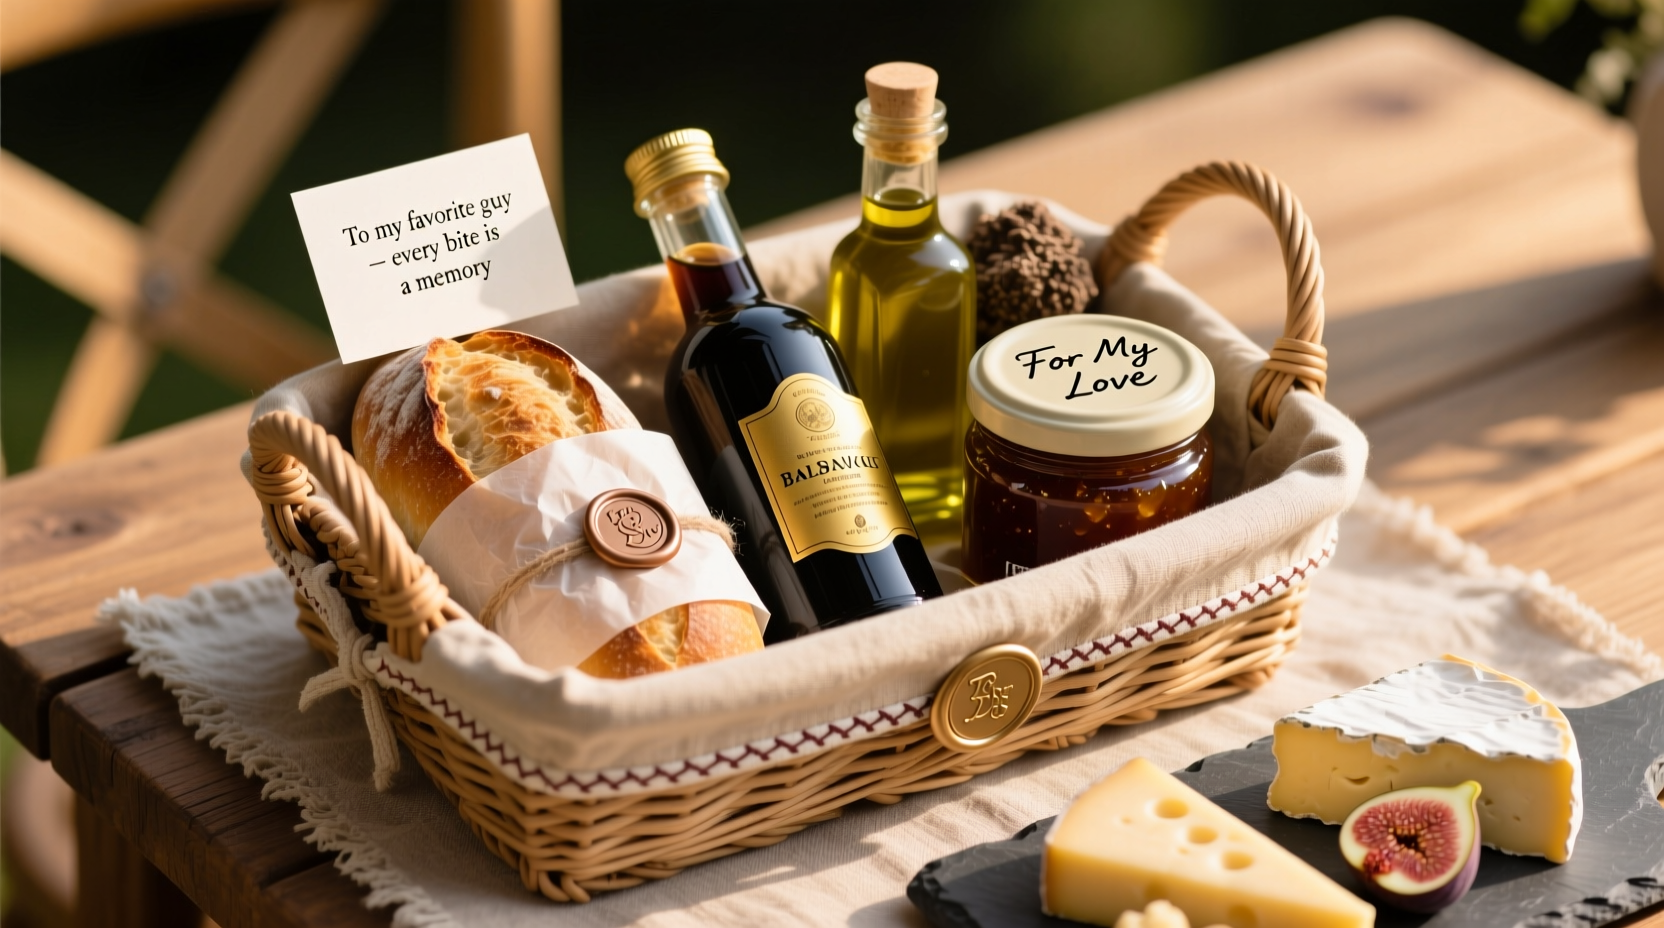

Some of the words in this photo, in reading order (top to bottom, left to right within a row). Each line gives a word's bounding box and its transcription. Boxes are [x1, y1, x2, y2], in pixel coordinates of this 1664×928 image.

[343, 226, 370, 247] To
[375, 221, 402, 241] my
[408, 201, 475, 231] favorite
[480, 193, 512, 218] guy
[392, 242, 439, 266] every
[442, 230, 480, 252] bite
[483, 223, 500, 242] is
[400, 281, 411, 295] a
[415, 259, 491, 292] memory
[1015, 345, 1083, 379] For
[1093, 336, 1158, 367] My
[1065, 371, 1158, 400] Love
